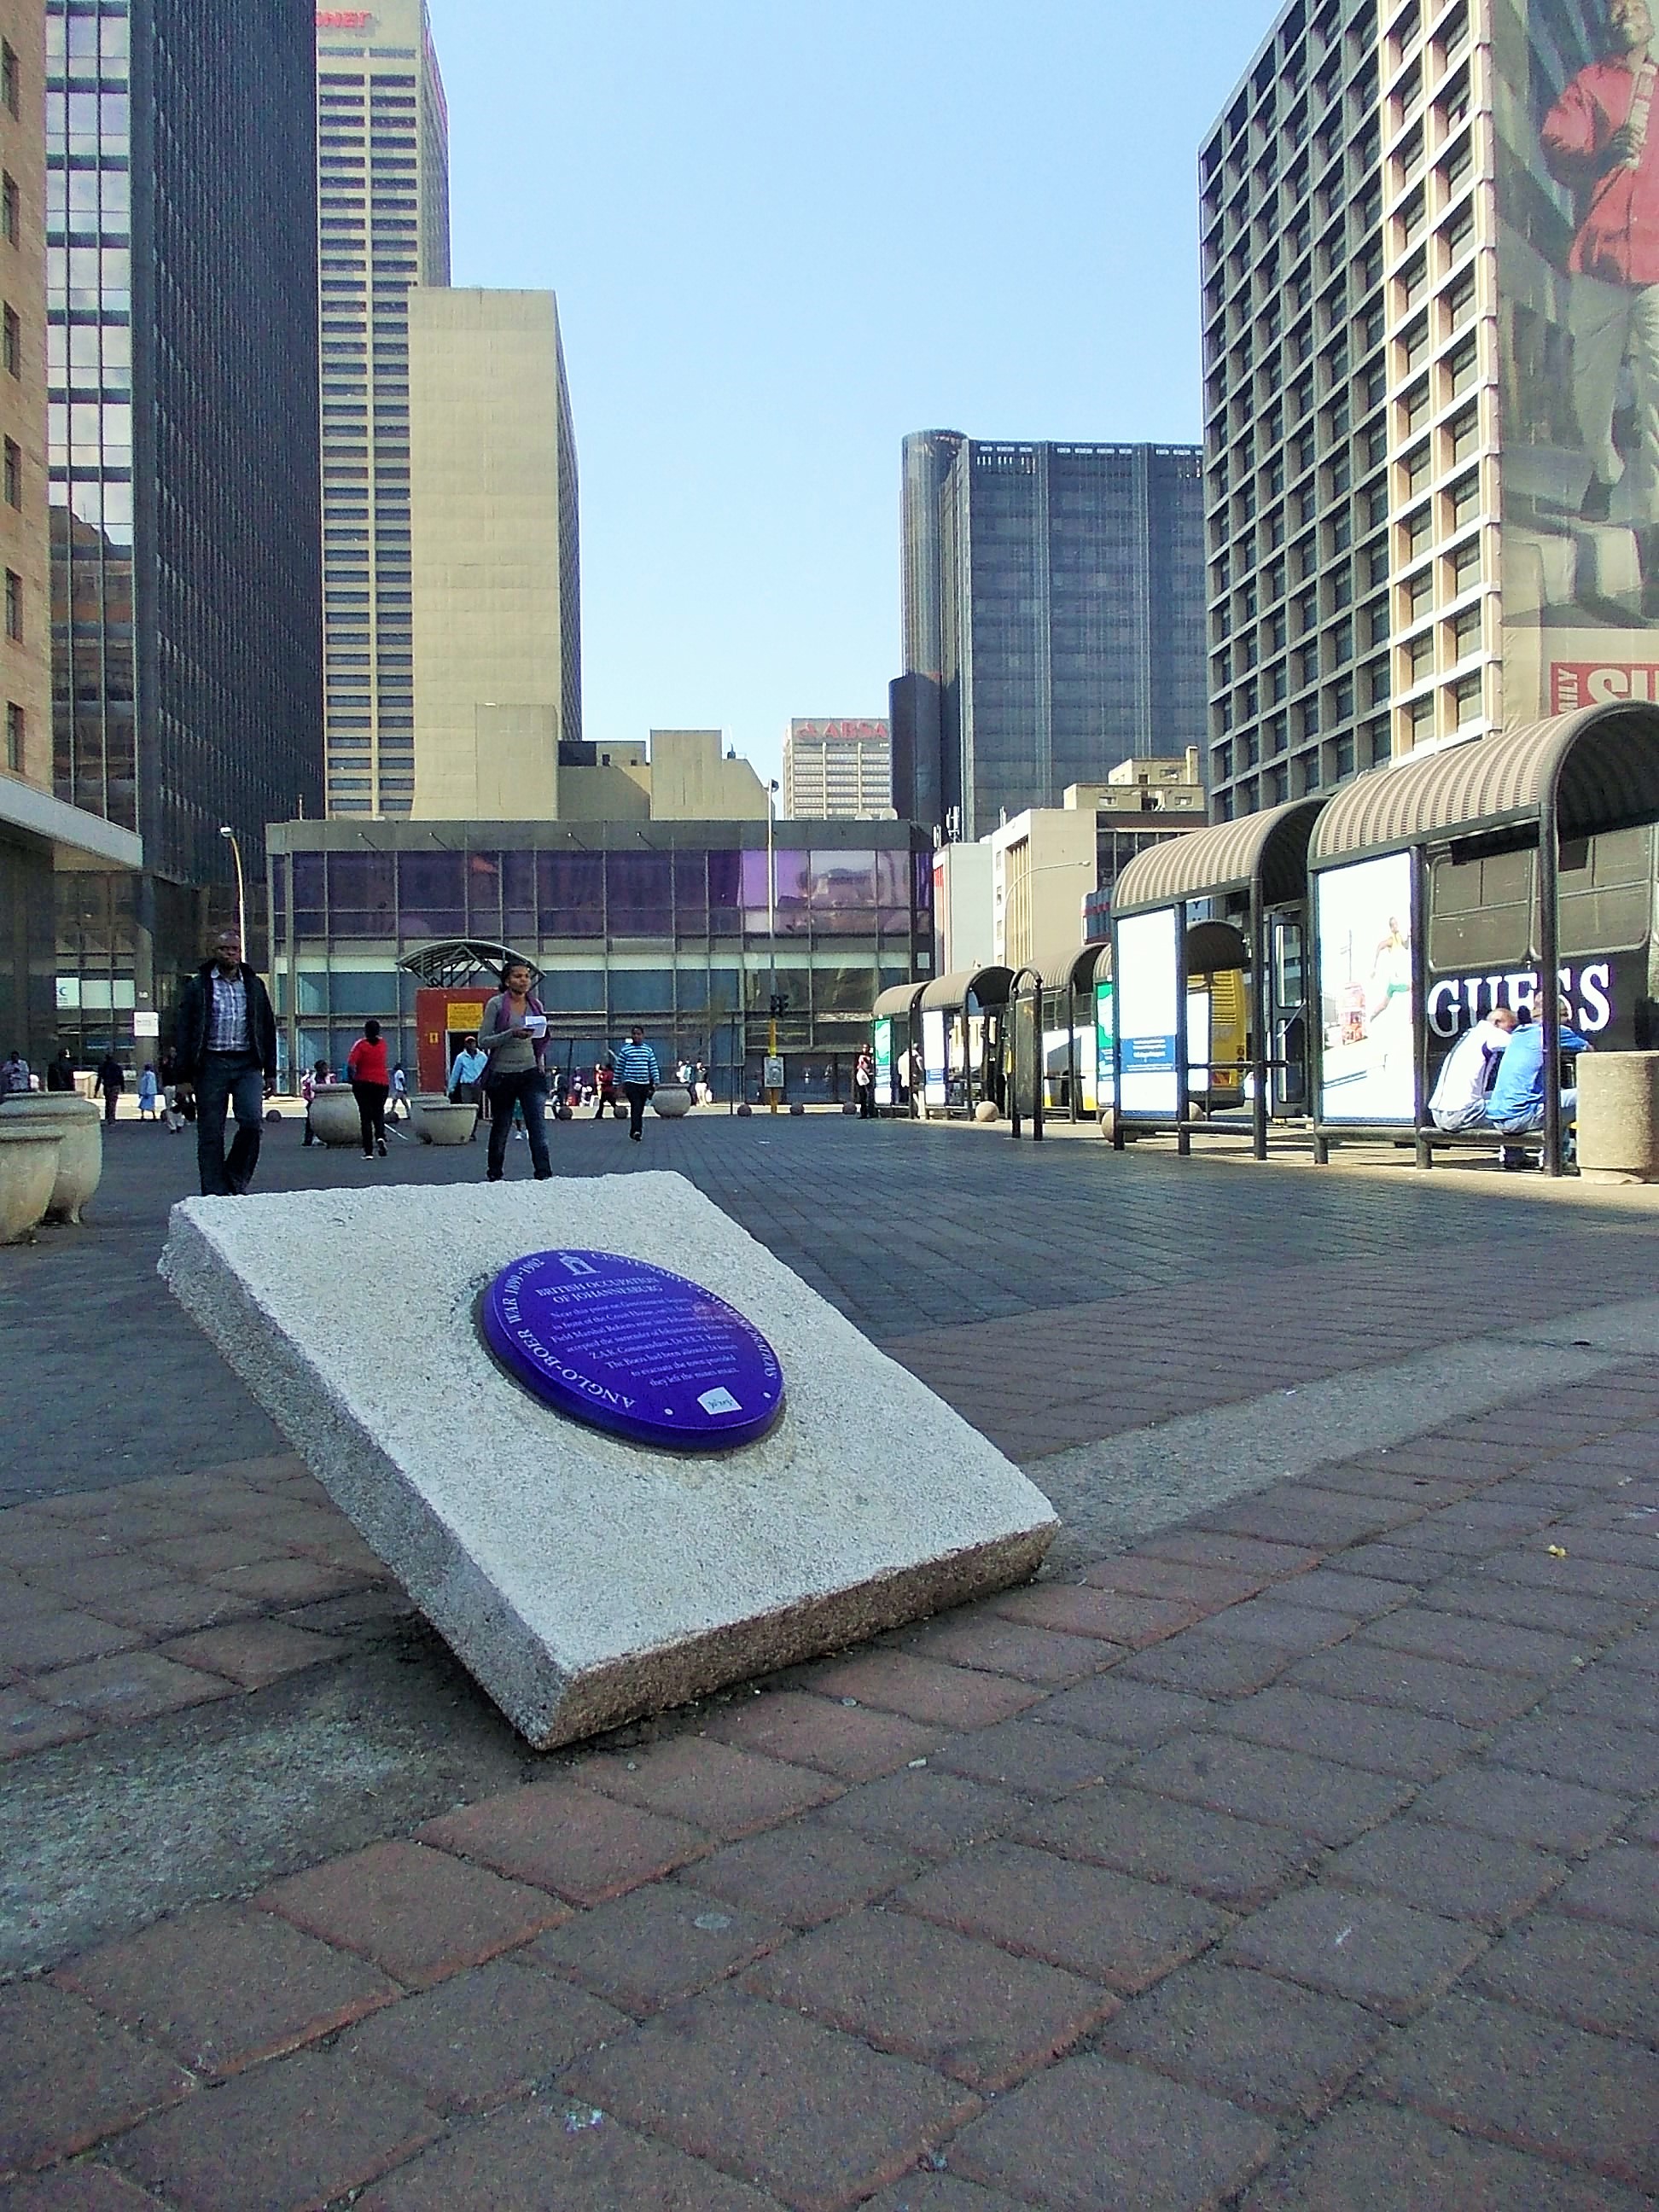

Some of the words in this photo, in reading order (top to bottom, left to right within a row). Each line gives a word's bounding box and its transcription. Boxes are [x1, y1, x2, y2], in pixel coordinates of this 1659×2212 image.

[823, 722, 888, 739] ABSA
[504, 1258, 545, 1295] 1899-1902
[536, 1283, 585, 1296] BRITISH
[552, 1295, 573, 1303] OF
[502, 1297, 522, 1324] WAR
[517, 1329, 637, 1408] ANGLO-BOER
